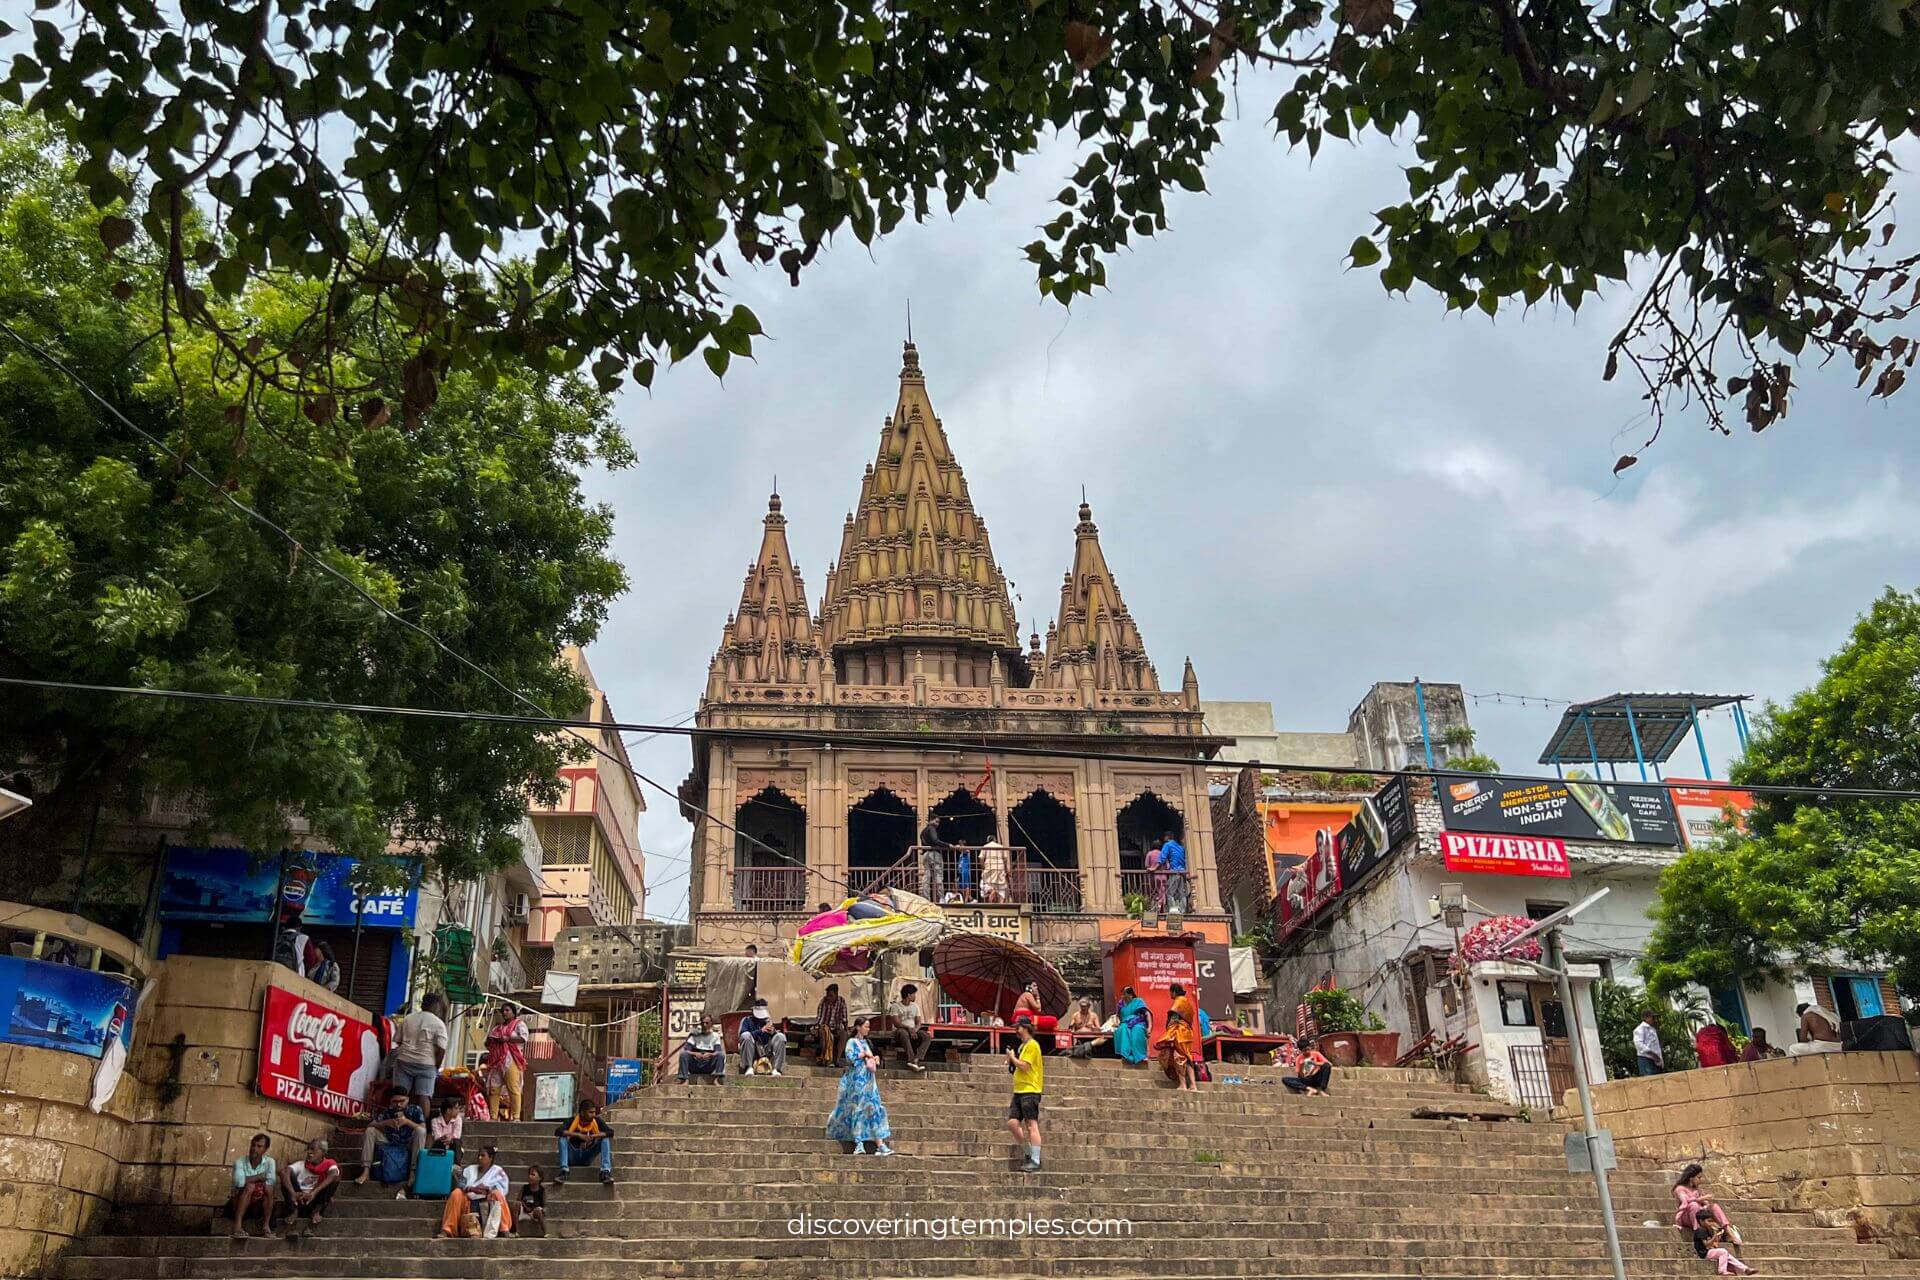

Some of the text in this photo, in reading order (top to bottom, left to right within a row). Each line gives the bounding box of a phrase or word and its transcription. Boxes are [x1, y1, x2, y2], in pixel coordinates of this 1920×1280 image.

[1503, 785, 1548, 799] NON-STOP
[1552, 789, 1568, 797] THE
[1453, 790, 1494, 814] ENERGY
[1503, 797, 1567, 818] NON-STOP
[1520, 808, 1562, 825] INDIAN
[1446, 835, 1563, 863] PIZZERIA
[350, 898, 404, 915] CAFÉ
[276, 1078, 313, 1105] PIZZA
[315, 1089, 351, 1114] TOWN
